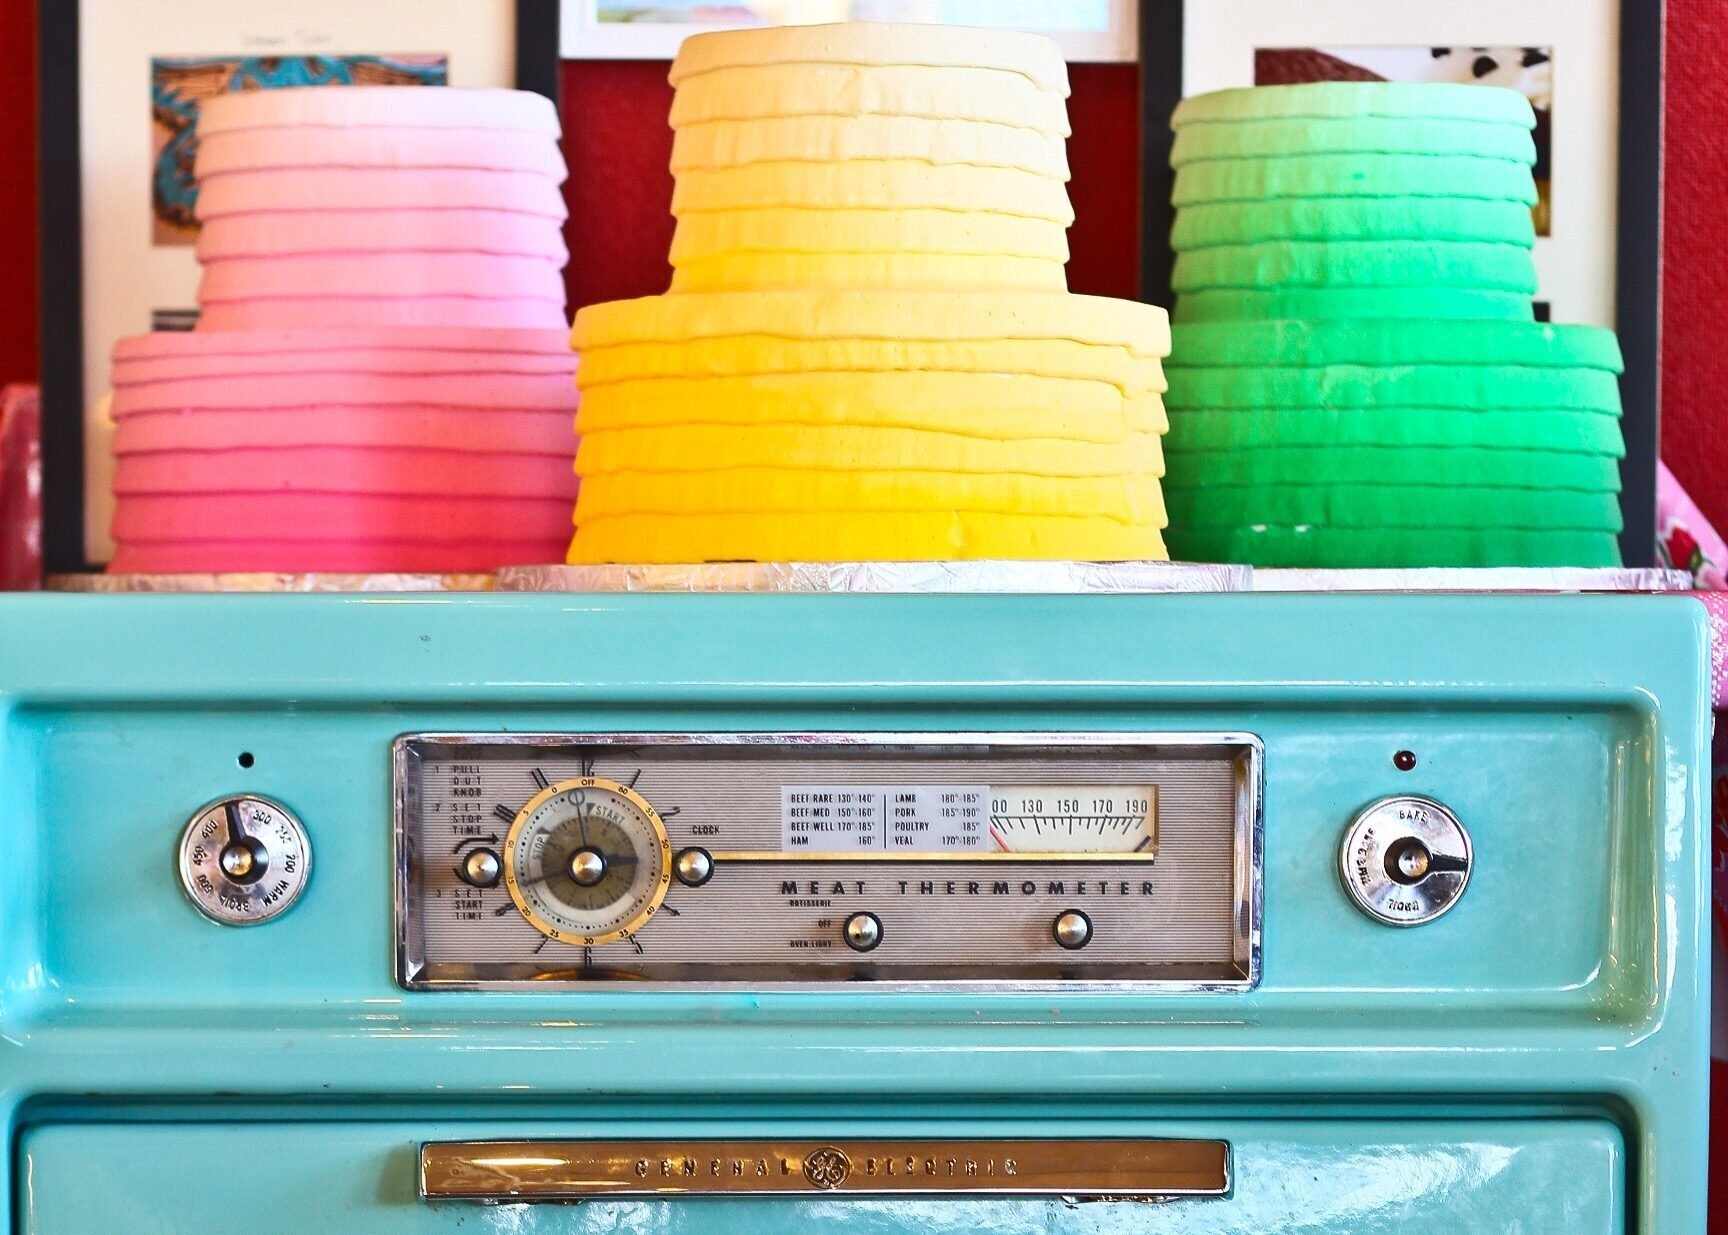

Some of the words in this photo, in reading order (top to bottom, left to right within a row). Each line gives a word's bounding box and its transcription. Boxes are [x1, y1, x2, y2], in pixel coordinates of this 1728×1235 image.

[453, 765, 480, 774] PULL
[453, 777, 482, 785] OUT
[453, 789, 482, 797] KNOB
[551, 786, 558, 794] 0
[618, 786, 629, 795] 60
[791, 794, 810, 804] BEEF
[813, 794, 833, 804] RARE
[895, 794, 916, 804] LAMB
[453, 803, 481, 812] SET
[992, 800, 1008, 813] 00
[1022, 800, 1043, 813] 130
[1057, 800, 1079, 813] 150
[1092, 800, 1113, 813] 170
[1126, 800, 1148, 813] 190
[252, 809, 272, 825] 300
[595, 805, 625, 825] START
[645, 807, 655, 817] 55
[791, 808, 810, 818] BEEF
[813, 808, 830, 818] MED
[895, 808, 916, 818] PORK
[1399, 810, 1430, 823] BAKE
[452, 814, 482, 824] STOP
[201, 820, 218, 839] 400
[452, 826, 482, 834] TIME
[692, 824, 720, 835] CLOCK
[791, 822, 810, 832] BEEF
[813, 822, 834, 832] WELL
[895, 822, 930, 832] POULTRY
[963, 821, 980, 832] 185°
[508, 840, 515, 849] 10
[661, 838, 670, 850] 50
[791, 836, 809, 846] HAM
[858, 836, 876, 846] 160°
[895, 836, 914, 846] VEAL
[532, 836, 546, 860] STOP
[193, 846, 205, 866] 450
[284, 854, 296, 874] 200
[198, 874, 214, 894] 500
[508, 876, 515, 884] 15
[661, 873, 670, 885] 45
[781, 880, 866, 895] MEAT
[898, 880, 1154, 895] THERMOMETER
[260, 880, 290, 907] WARM
[455, 890, 483, 898] SET
[219, 894, 250, 912] BROIL
[455, 901, 483, 909] START
[790, 899, 832, 907] ROTISSERIE
[455, 912, 482, 920] TIME
[522, 906, 532, 917] 20
[646, 906, 656, 916] 40
[818, 920, 831, 928] OFF
[550, 929, 560, 938] 25
[618, 929, 629, 938] 35
[584, 937, 594, 945] 30
[790, 940, 809, 948] OVEN
[634, 1157, 791, 1179] GENERAL
[866, 1157, 1018, 1177] ELECTRIC
